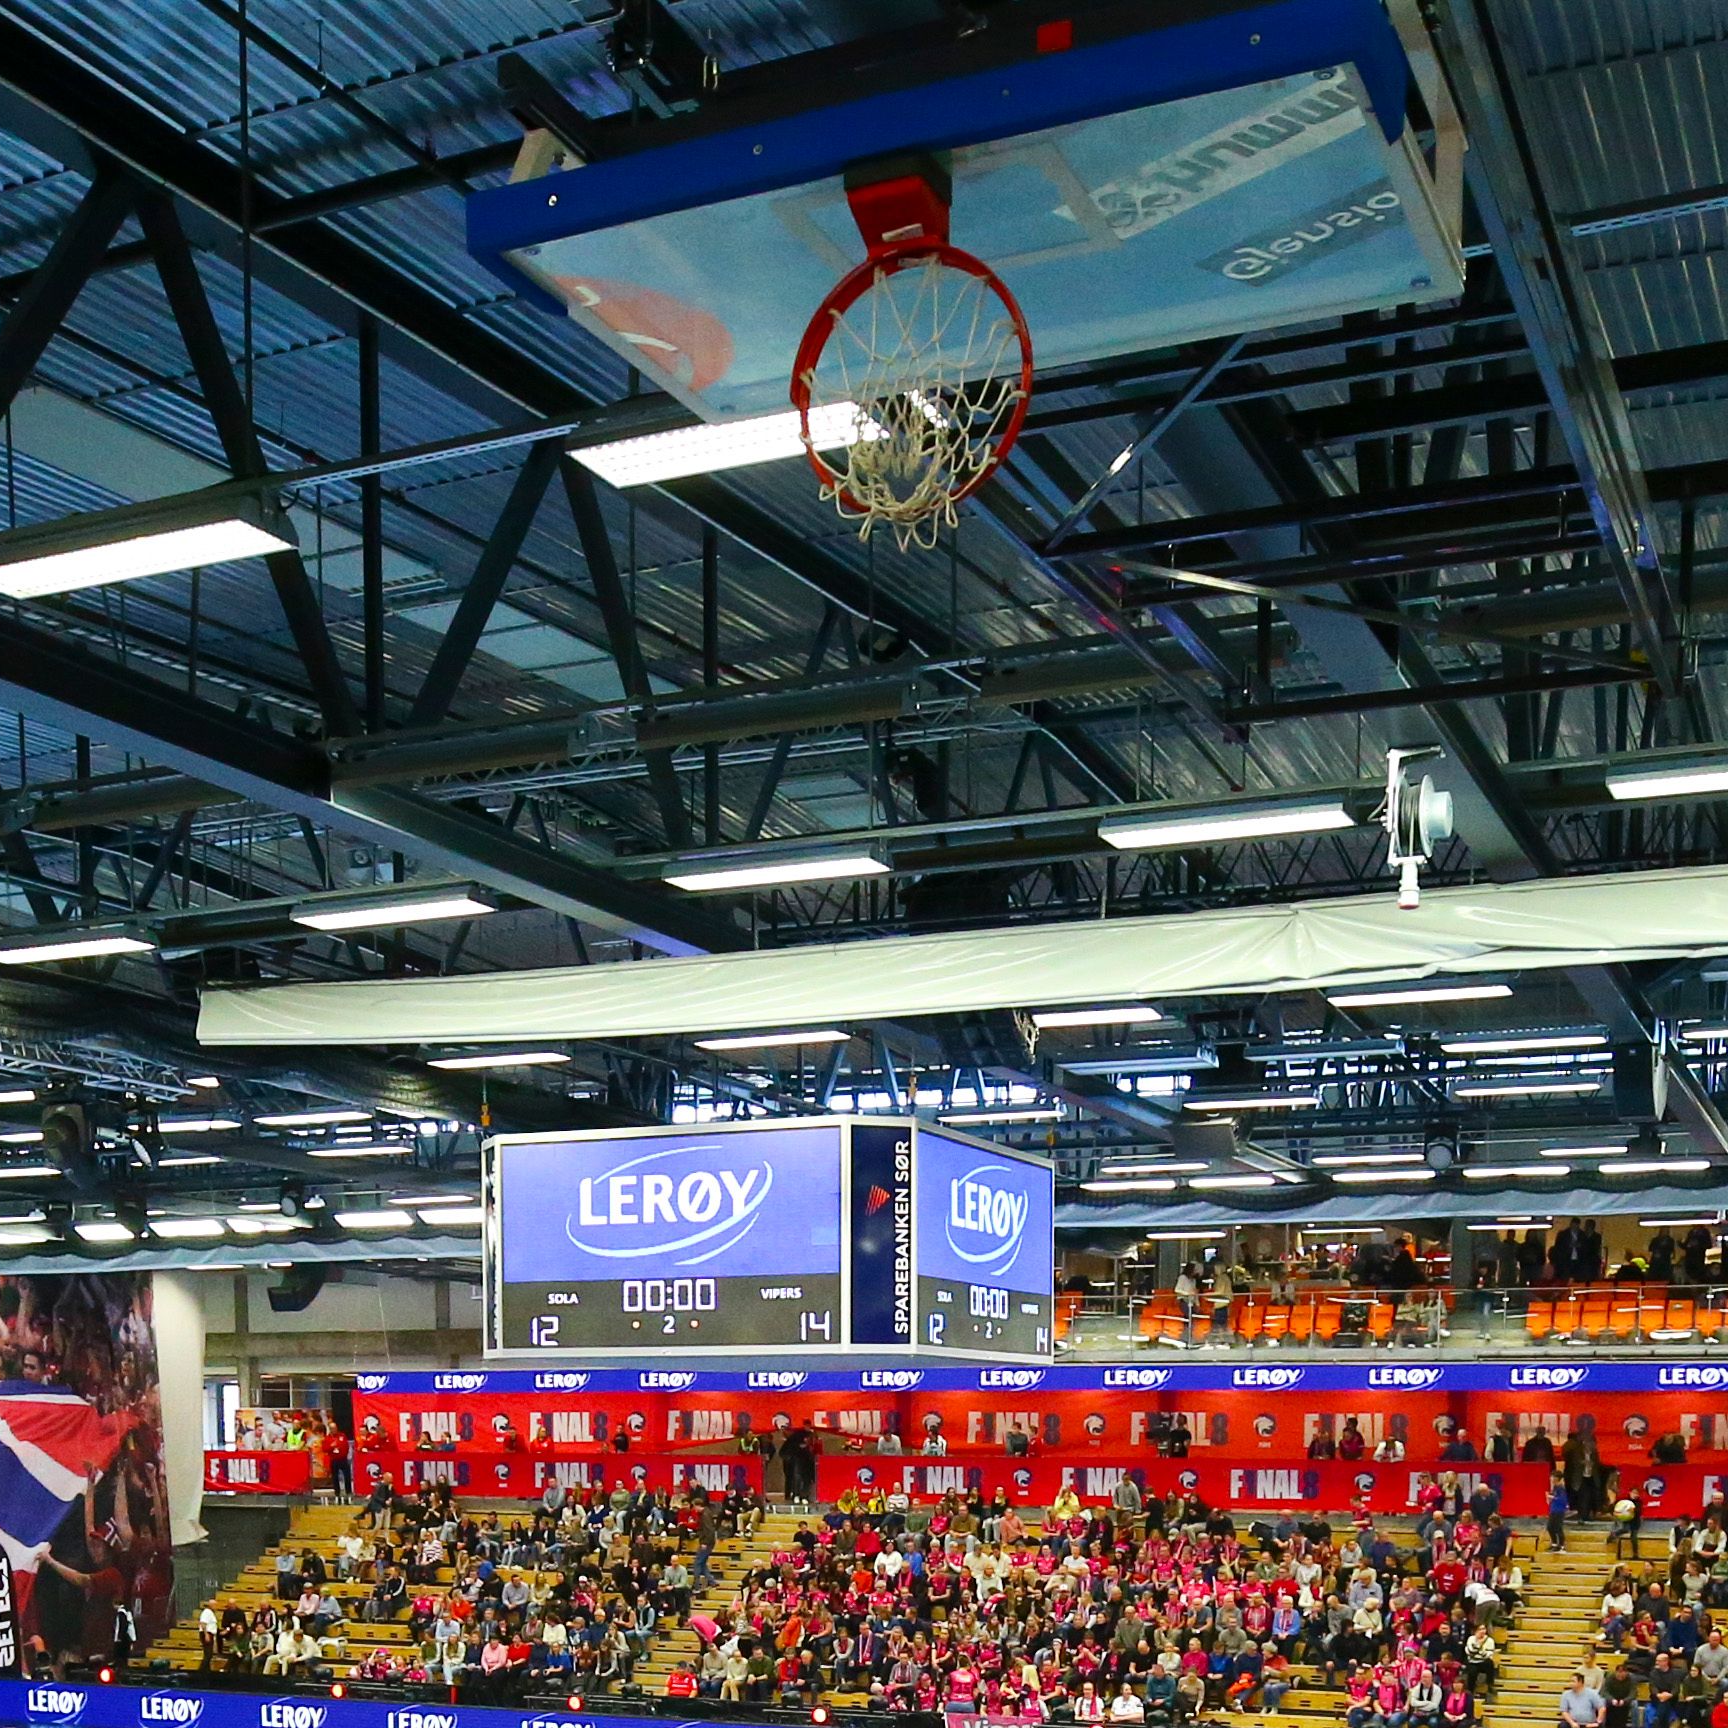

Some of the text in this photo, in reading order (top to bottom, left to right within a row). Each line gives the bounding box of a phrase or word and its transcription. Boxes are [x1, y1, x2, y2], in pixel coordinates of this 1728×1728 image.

[579, 1170, 758, 1225] LERØY
[950, 1177, 1023, 1237] LERØY
[895, 1141, 909, 1334] SPAREBANKEN SØR
[548, 1293, 578, 1306] SOLA
[623, 1279, 715, 1311] 00:00
[760, 1287, 801, 1300] VIPERS
[970, 1286, 1008, 1319] 00:00
[530, 1316, 560, 1346] 12
[663, 1316, 674, 1334] 2
[799, 1312, 830, 1342] 14
[928, 1314, 944, 1343] 12
[985, 1322, 992, 1338] 2
[1036, 1327, 1048, 1351] 14
[434, 1375, 485, 1389] LERØY
[535, 1373, 587, 1388] LERØY
[640, 1373, 694, 1388] LERØY
[748, 1372, 805, 1388] LERØY
[862, 1371, 921, 1387] LERØY
[980, 1370, 1042, 1386] LERØY
[1104, 1369, 1170, 1385] LERØY
[1233, 1369, 1301, 1385] LERØY
[1369, 1368, 1440, 1385] LERØY
[1510, 1368, 1584, 1385] LERØY
[28, 1688, 85, 1714] LERØY
[141, 1696, 202, 1723] LERØY
